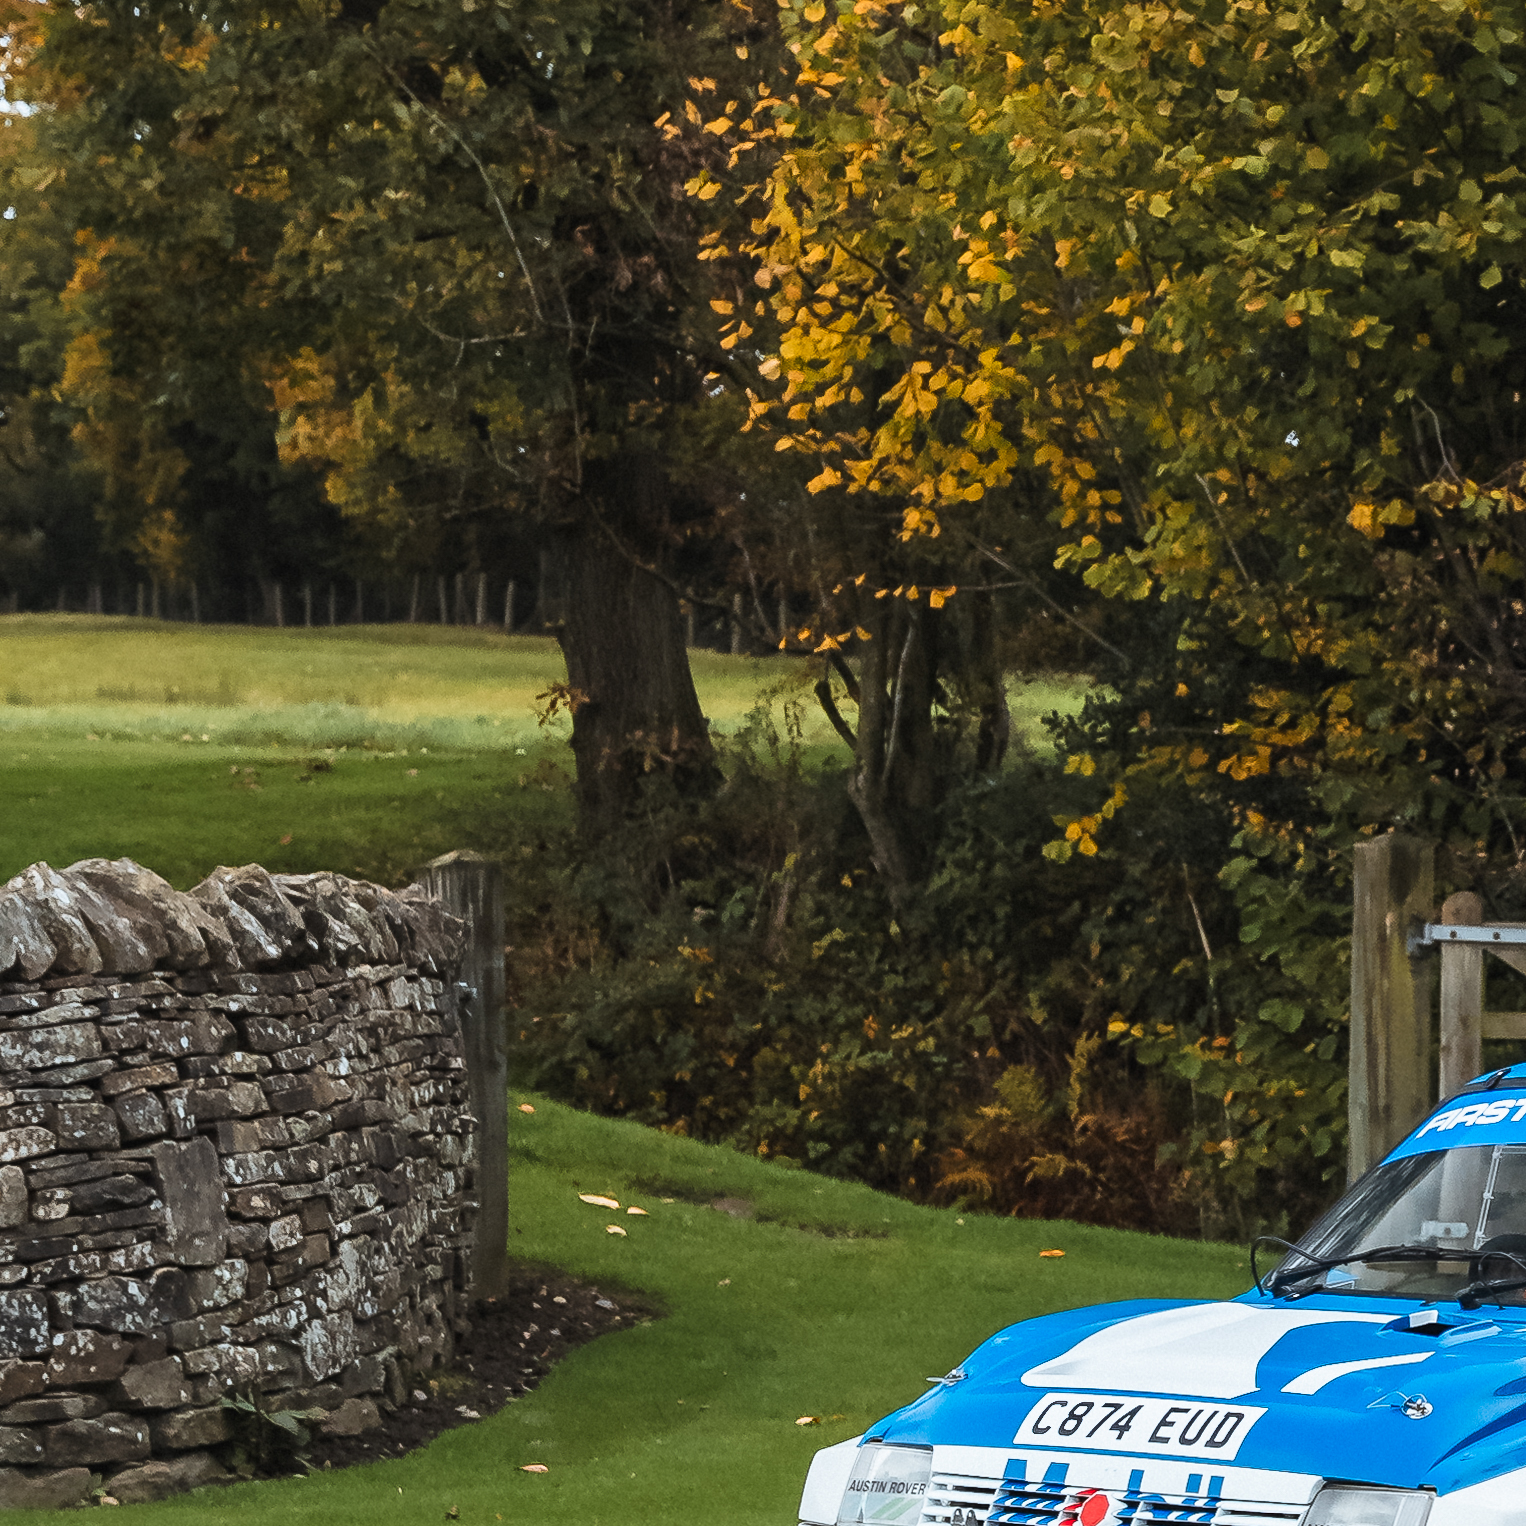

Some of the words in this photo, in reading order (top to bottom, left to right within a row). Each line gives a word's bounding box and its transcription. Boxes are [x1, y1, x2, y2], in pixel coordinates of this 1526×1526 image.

[1032, 1400, 1144, 1440] C874
[1148, 1407, 1245, 1448] EUD
[848, 1479, 888, 1493] AUSTIN
[888, 1481, 927, 1495] ROVER
